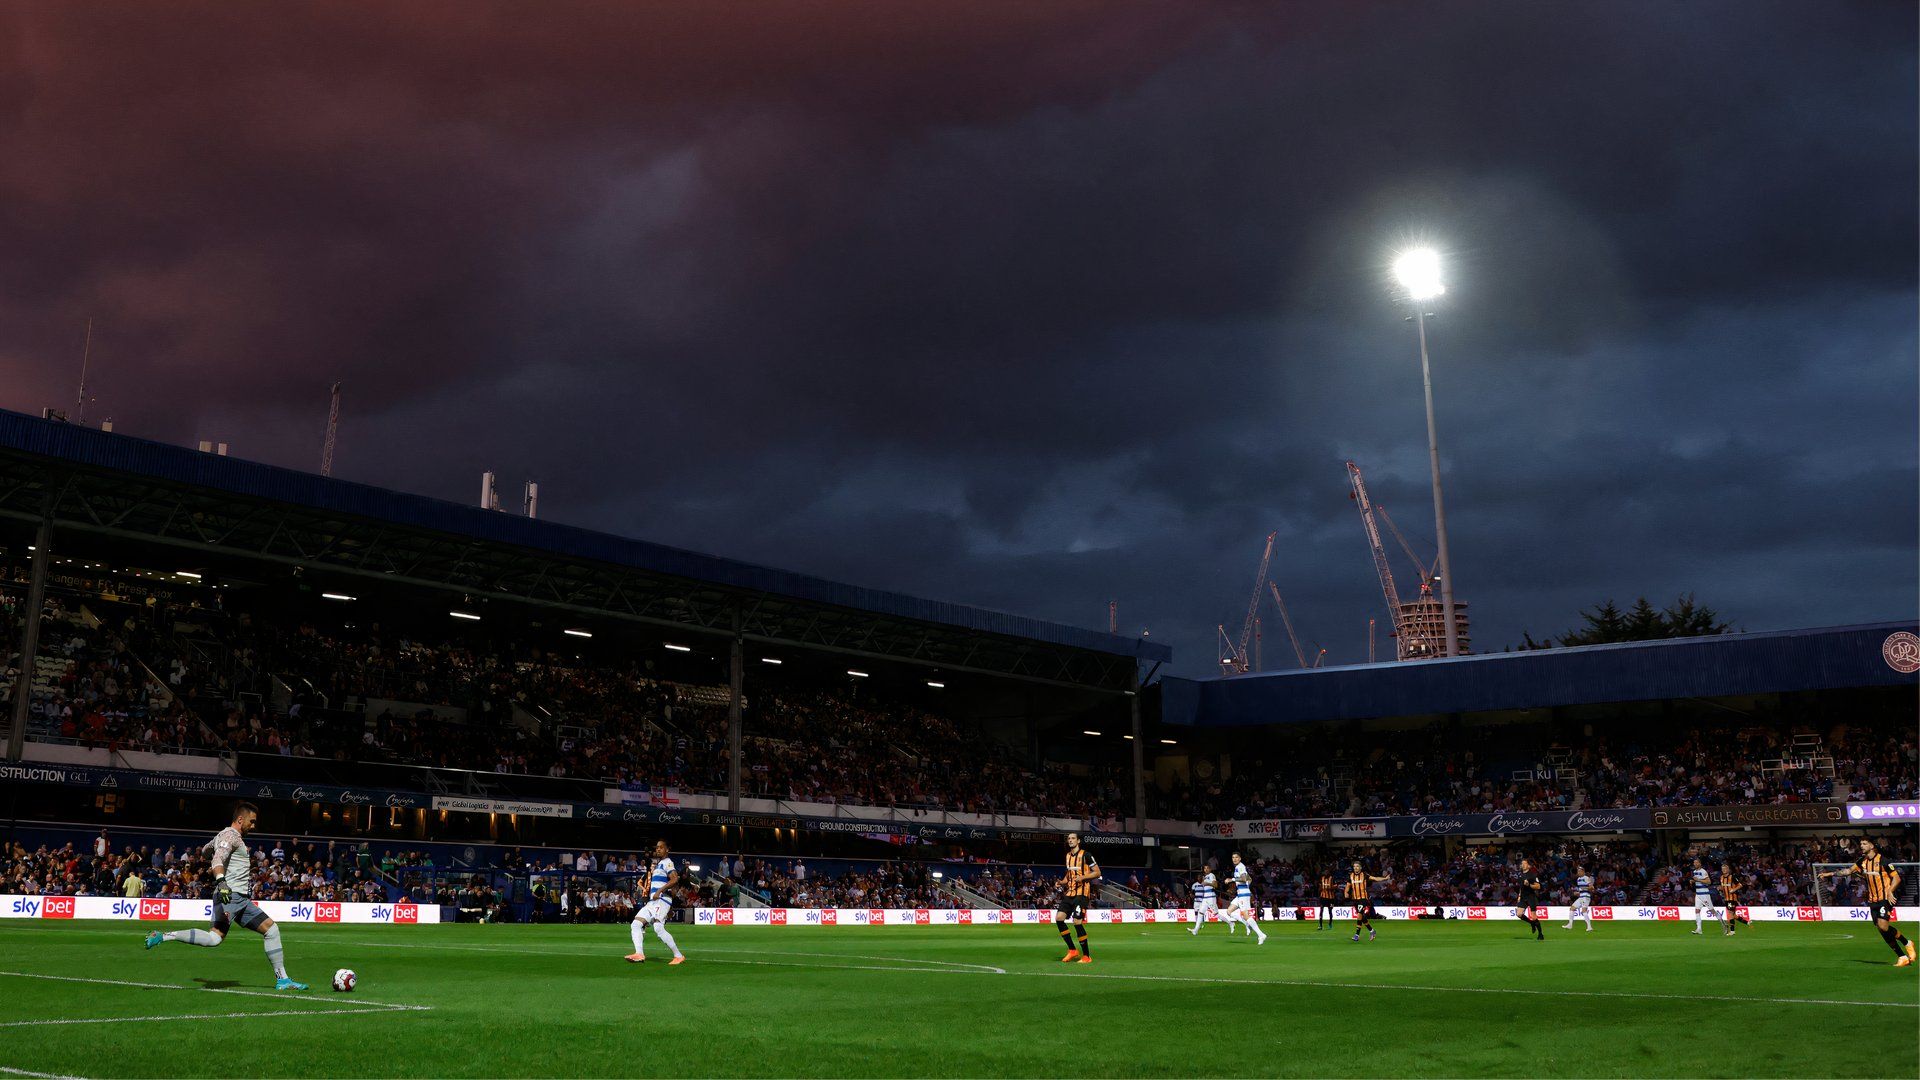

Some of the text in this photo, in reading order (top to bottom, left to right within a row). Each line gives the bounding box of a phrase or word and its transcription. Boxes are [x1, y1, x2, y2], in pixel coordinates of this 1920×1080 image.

[118, 582, 148, 595] Press
[1567, 812, 1625, 831] Convivia
[1676, 808, 1818, 823] ASHVILLE AGGREGATES
[820, 821, 844, 830] GROUND
[844, 822, 887, 832] CONSTRUCTION
[1412, 816, 1465, 835] Convivia
[1488, 814, 1542, 834] Convivia
[13, 897, 72, 917] sky bet
[112, 899, 167, 918] sky bet
[291, 903, 339, 920] sky bet
[372, 905, 416, 921] sky bet
[1075, 905, 1081, 916] 4
[1336, 908, 1350, 919] sky
[1392, 908, 1407, 919] sky
[1450, 907, 1485, 918] sky bet
[1593, 907, 1611, 917] bet
[1638, 906, 1678, 919] sky bet
[1777, 907, 1819, 919] sky bet
[1850, 907, 1869, 920] sky
[699, 910, 732, 923] sky bet
[754, 910, 786, 923] sky bet
[806, 910, 835, 923] sky bet
[855, 910, 883, 923] sky bet
[902, 910, 929, 923] sky bet
[946, 910, 971, 922] sky bet
[988, 910, 1012, 922] sky bet
[1028, 910, 1050, 922] sky bet
[1101, 910, 1121, 921] sky bet
[1135, 910, 1155, 921] sky bet
[1168, 909, 1186, 920] sky bet
[1281, 909, 1295, 919] sky
